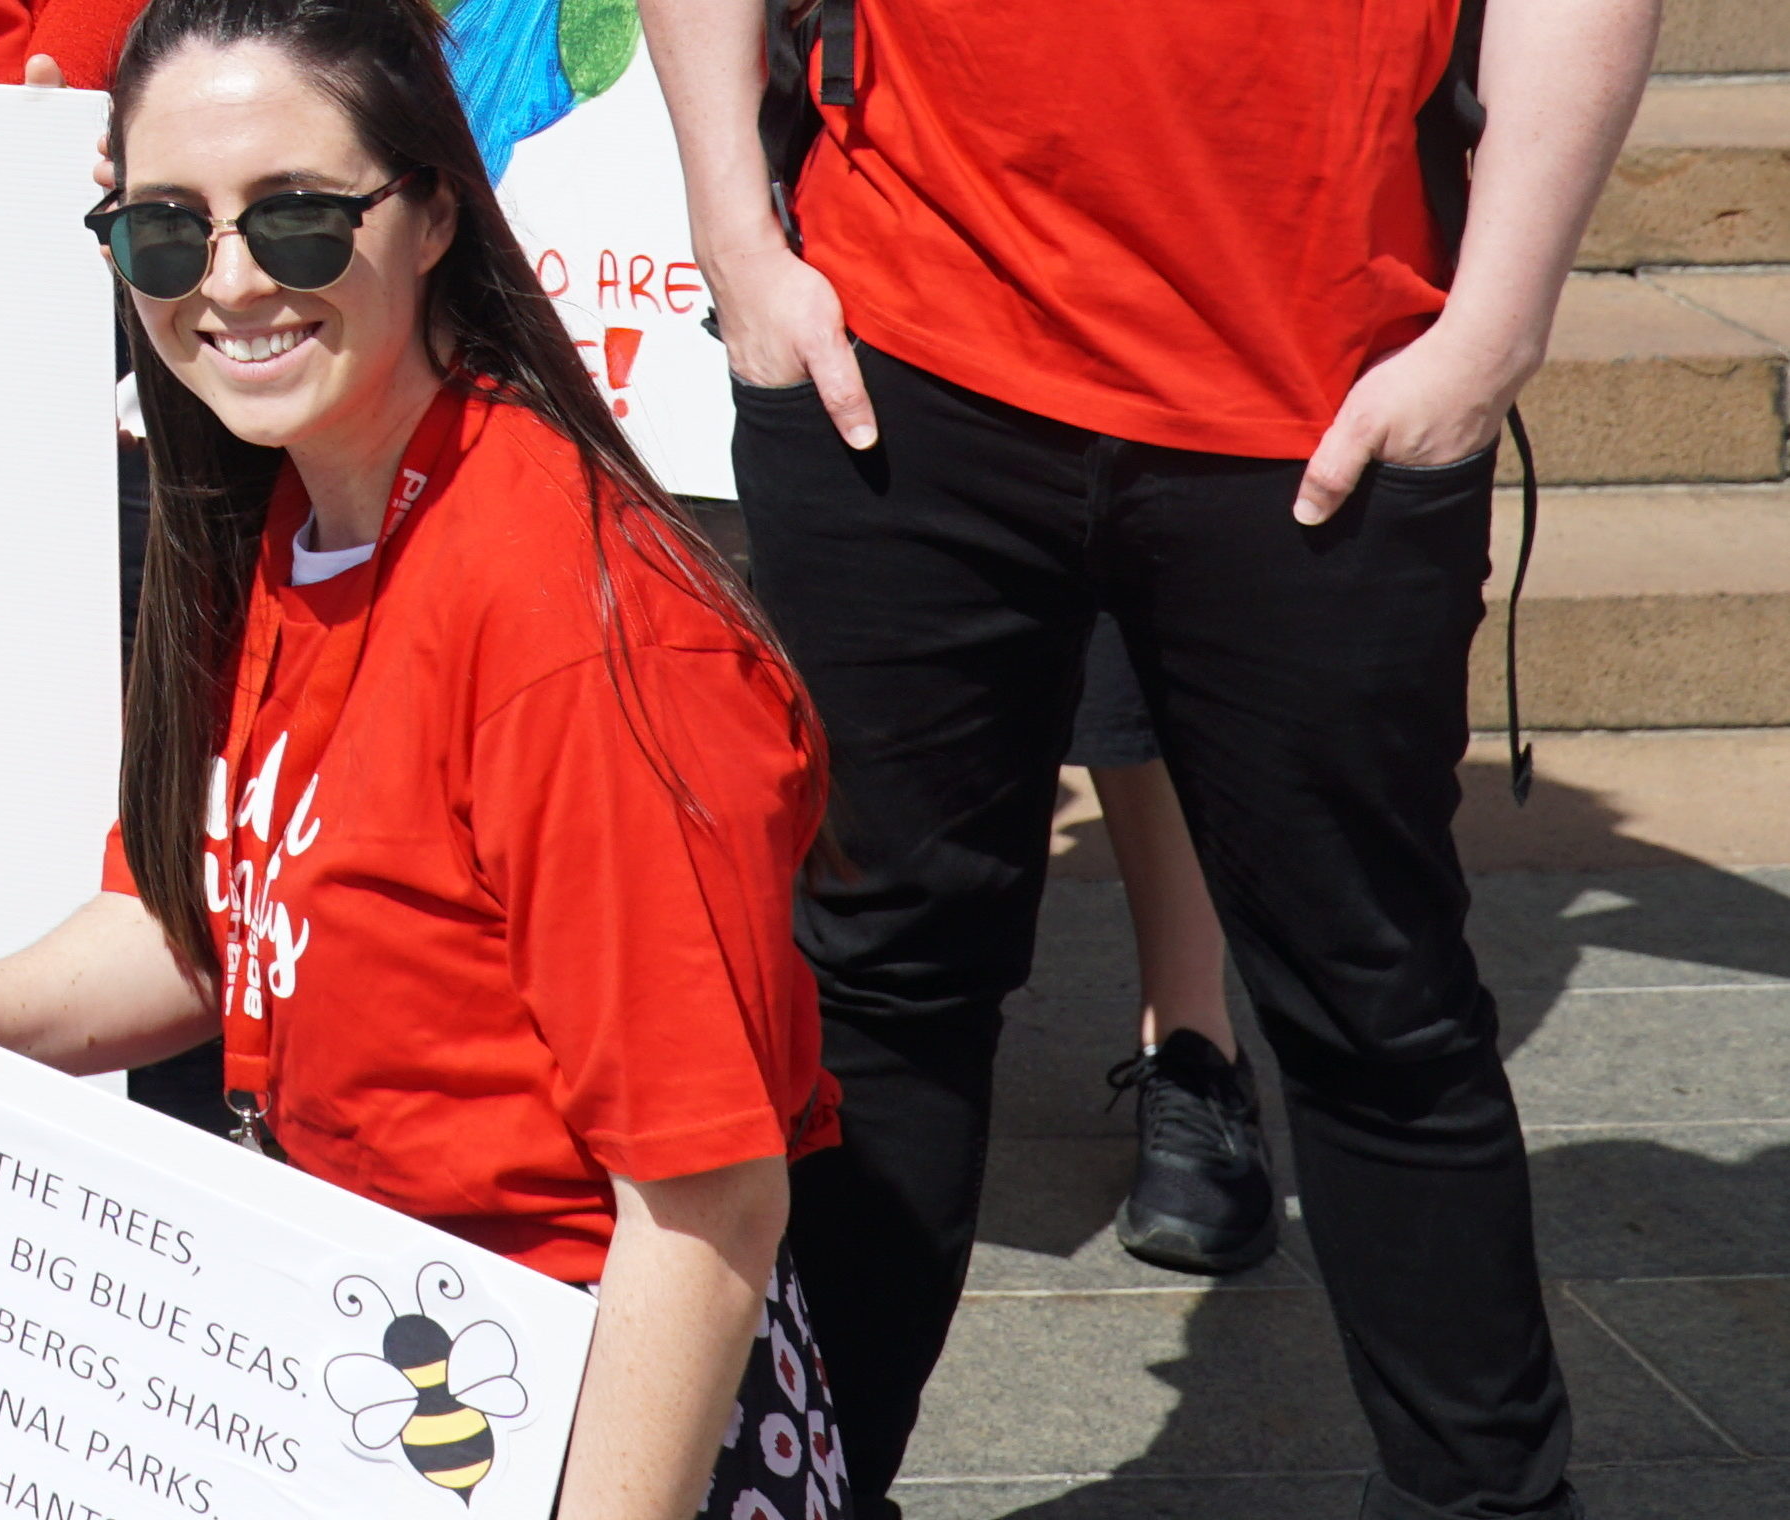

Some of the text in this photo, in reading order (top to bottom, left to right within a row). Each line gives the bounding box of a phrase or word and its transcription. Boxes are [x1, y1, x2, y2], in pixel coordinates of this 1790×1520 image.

[536, 248, 703, 314] O ARE
[77, 1185, 201, 1277] TREES,
[10, 1237, 78, 1292] BIG
[89, 1272, 193, 1343] BLUE
[201, 1322, 308, 1399] SEAS.
[142, 1376, 301, 1474] SHARKS
[85, 1429, 219, 1520] PARKS.
